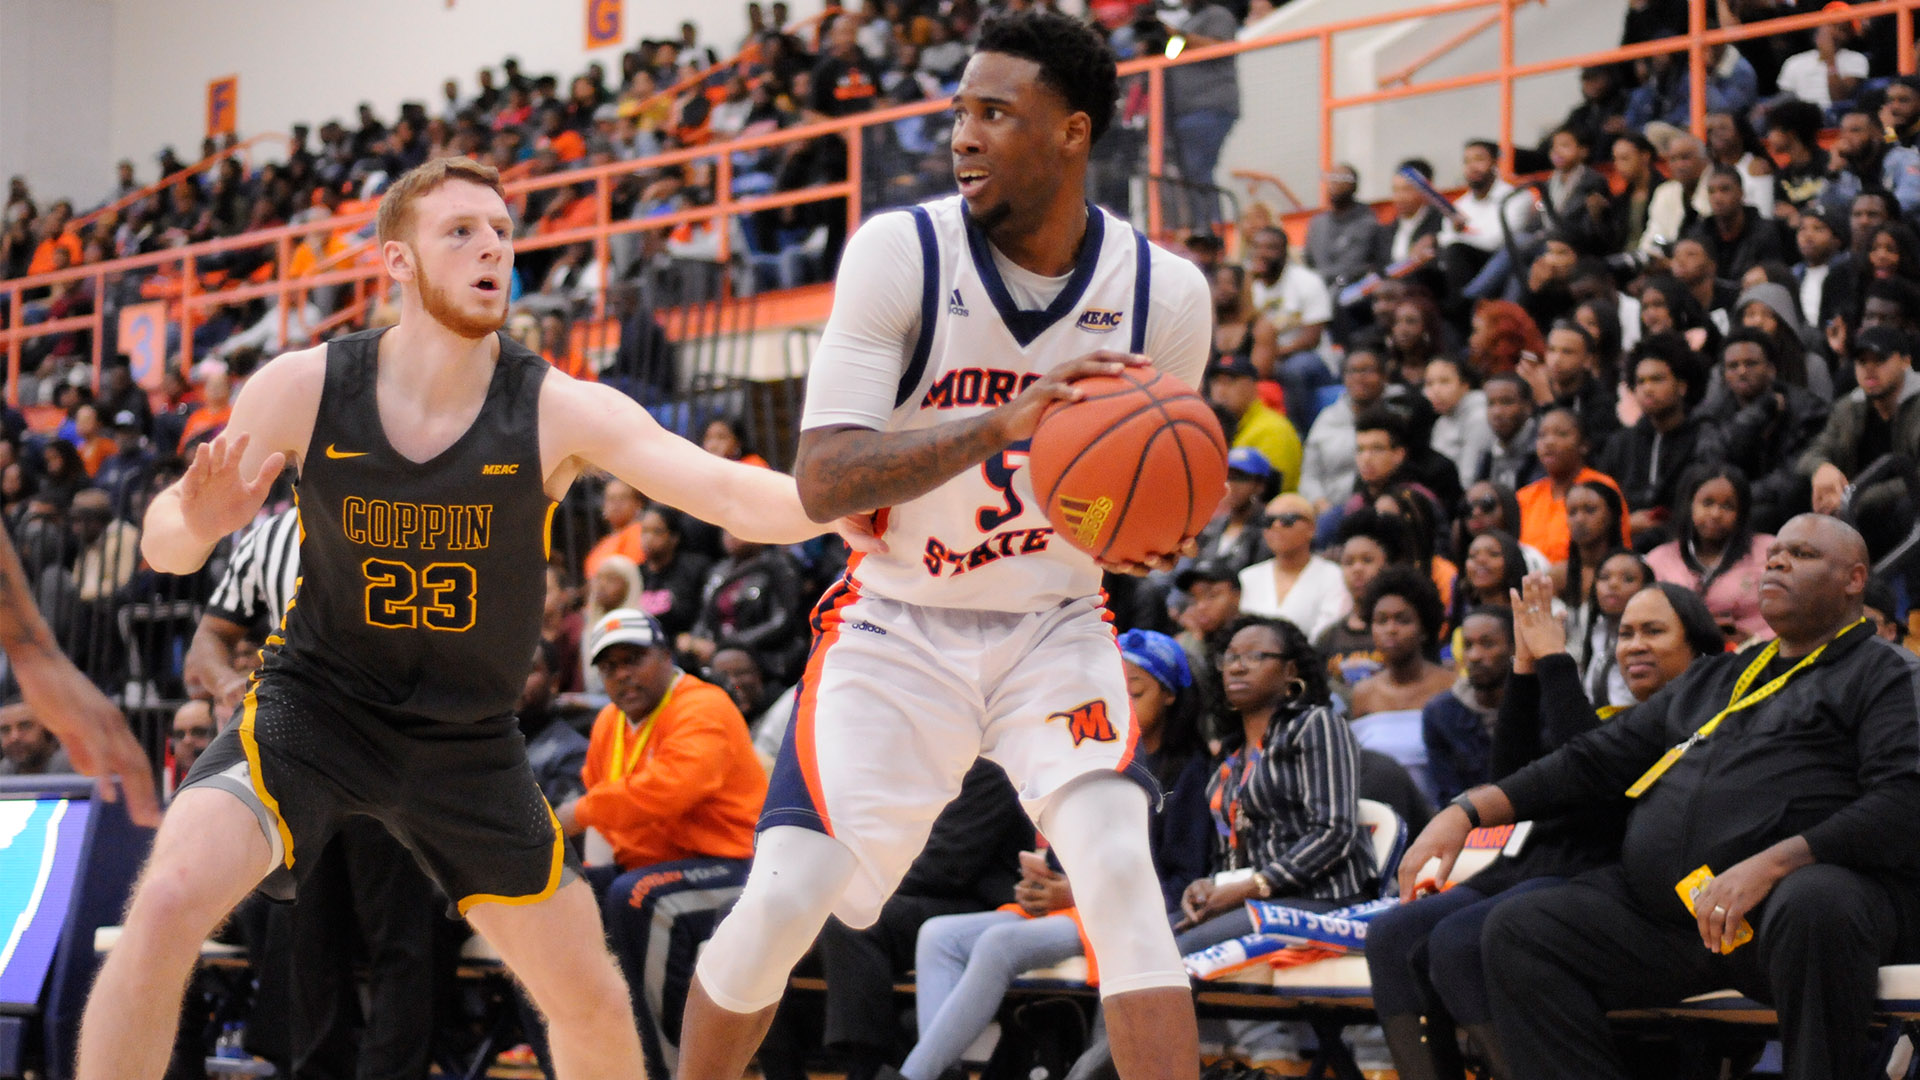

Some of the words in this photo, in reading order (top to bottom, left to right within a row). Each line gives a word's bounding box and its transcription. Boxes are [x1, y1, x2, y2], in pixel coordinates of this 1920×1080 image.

[589, 0, 620, 40] G
[211, 83, 231, 128] F
[1075, 311, 1124, 327] MEAC
[129, 315, 154, 383] 3
[482, 464, 519, 475] MEAC
[975, 437, 1034, 533] 5
[343, 495, 493, 550] COPPIN
[923, 527, 1055, 578] STATE
[362, 557, 477, 632] 23
[852, 619, 887, 635] adidas
[1045, 697, 1120, 749] M
[1262, 904, 1319, 931] LET'S
[1320, 914, 1348, 938] GO
[1353, 920, 1367, 941] B
